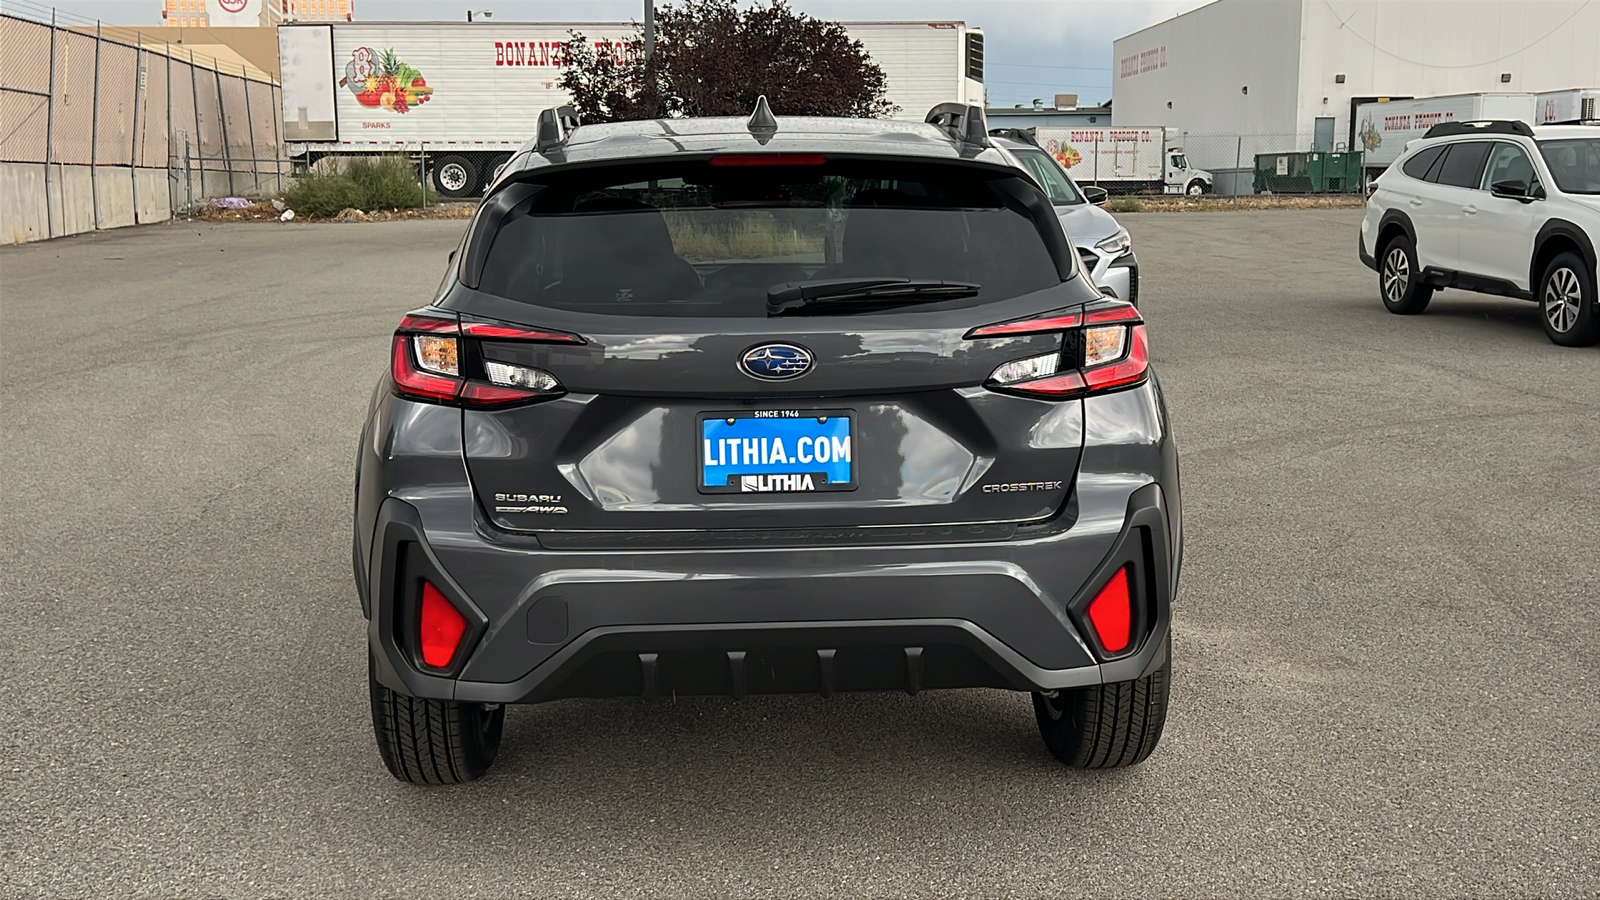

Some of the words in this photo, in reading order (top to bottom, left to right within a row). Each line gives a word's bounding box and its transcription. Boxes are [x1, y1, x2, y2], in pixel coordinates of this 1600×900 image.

[362, 121, 391, 129] SPARKS
[1071, 131, 1104, 142] BONANZA
[1109, 131, 1139, 142] PRODUCE
[1141, 131, 1152, 142] CO.
[781, 410, 800, 418] 1946
[704, 435, 852, 466] LITHIA.COM
[758, 474, 815, 491] LITHIA
[982, 480, 1063, 493] CROSSTREK
[494, 493, 562, 503] SUBARU
[523, 506, 569, 514] AWD
